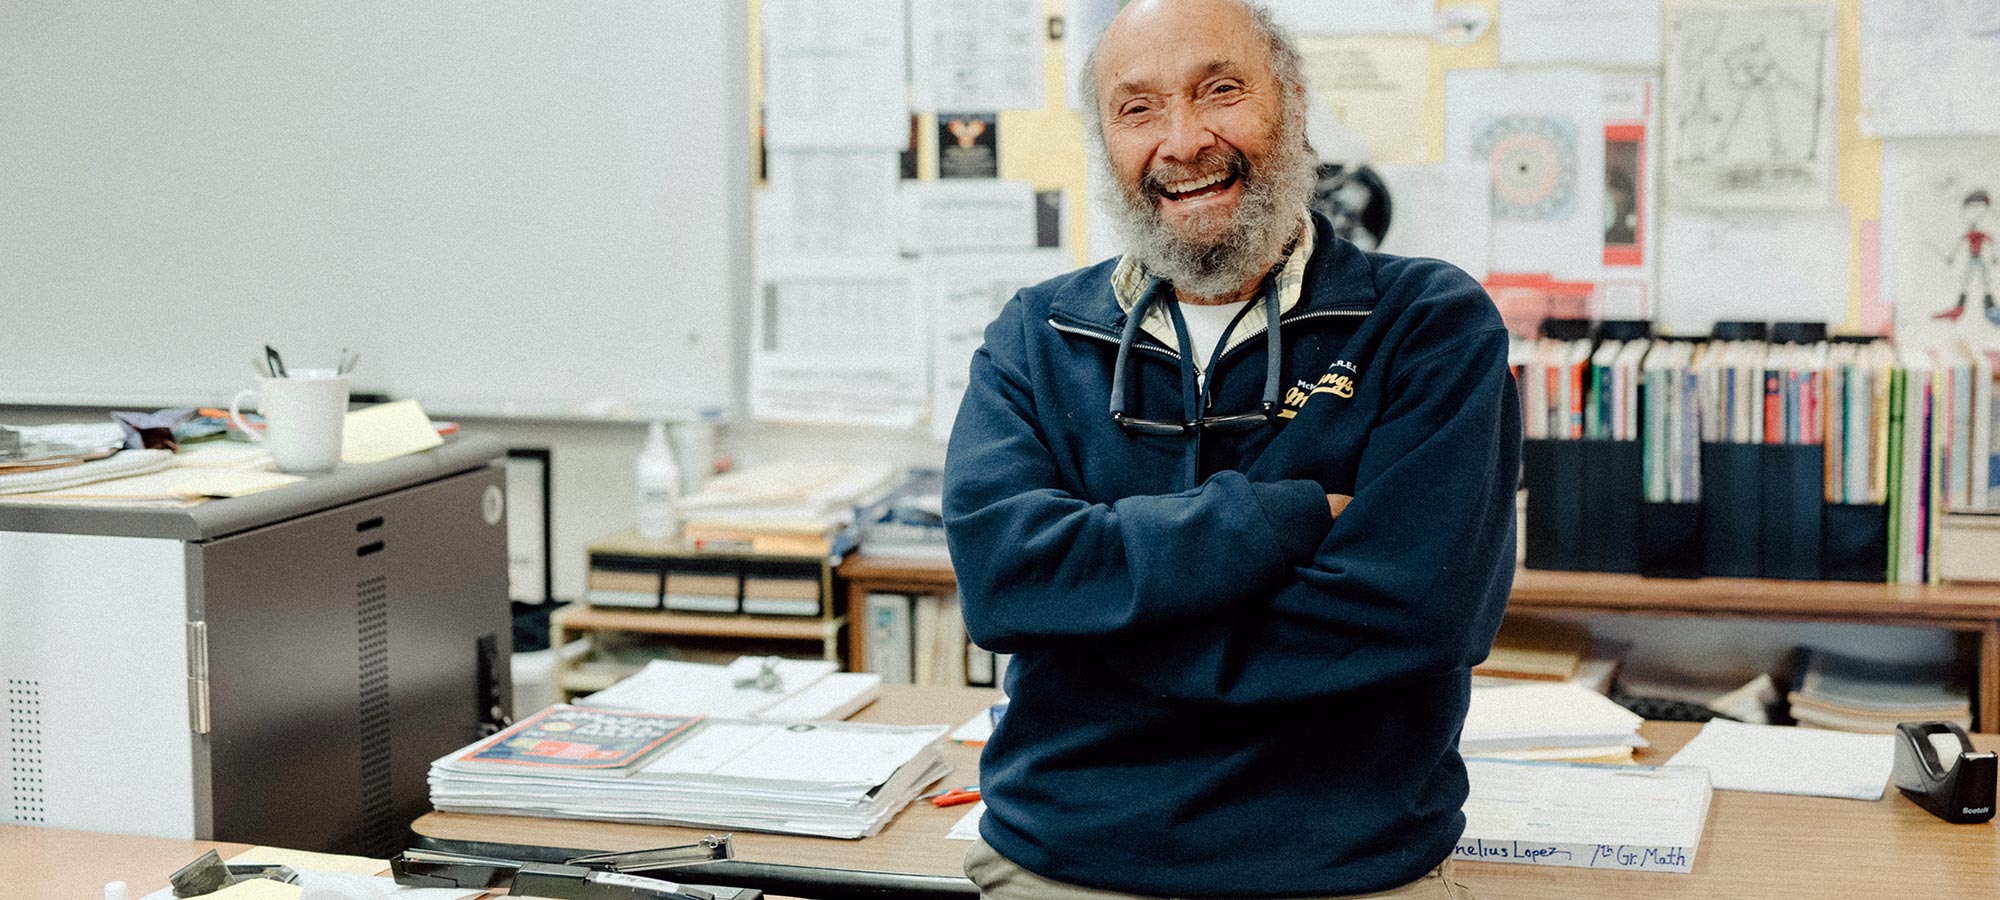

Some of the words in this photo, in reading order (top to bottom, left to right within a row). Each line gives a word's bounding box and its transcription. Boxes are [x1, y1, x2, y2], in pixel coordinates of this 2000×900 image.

[1962, 806, 1990, 815] Scotch
[1455, 838, 1508, 858] nelius
[1513, 840, 1571, 862] Lopez
[1640, 846, 1687, 867] Math
